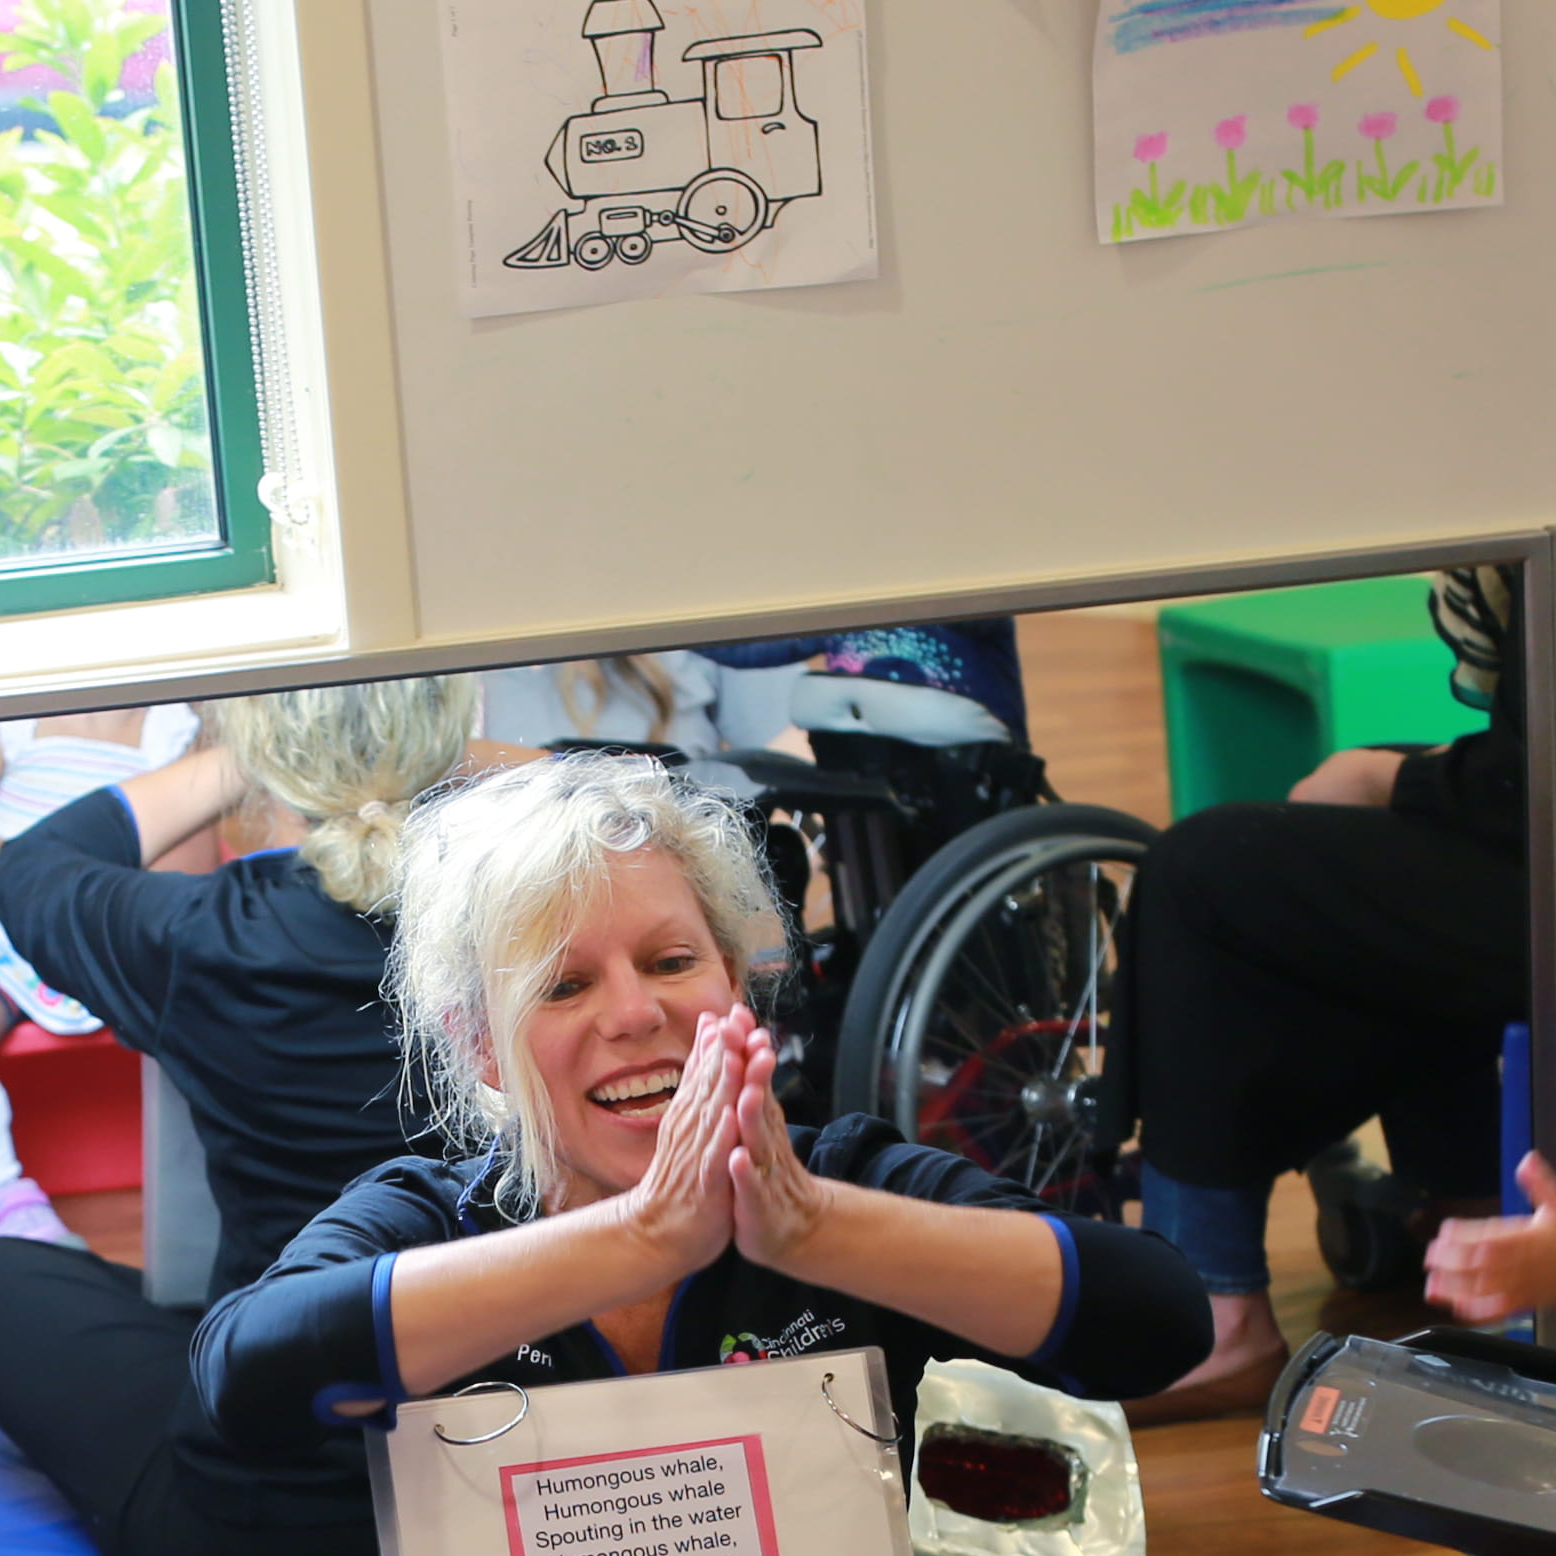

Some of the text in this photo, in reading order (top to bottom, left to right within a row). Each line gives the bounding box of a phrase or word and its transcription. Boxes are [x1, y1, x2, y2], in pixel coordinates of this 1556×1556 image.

[537, 1455, 723, 1496] Humongous whale,
[544, 1480, 725, 1521] Humongous whale
[535, 1505, 742, 1550] Spouting in the water
[674, 1531, 737, 1553] whale,
